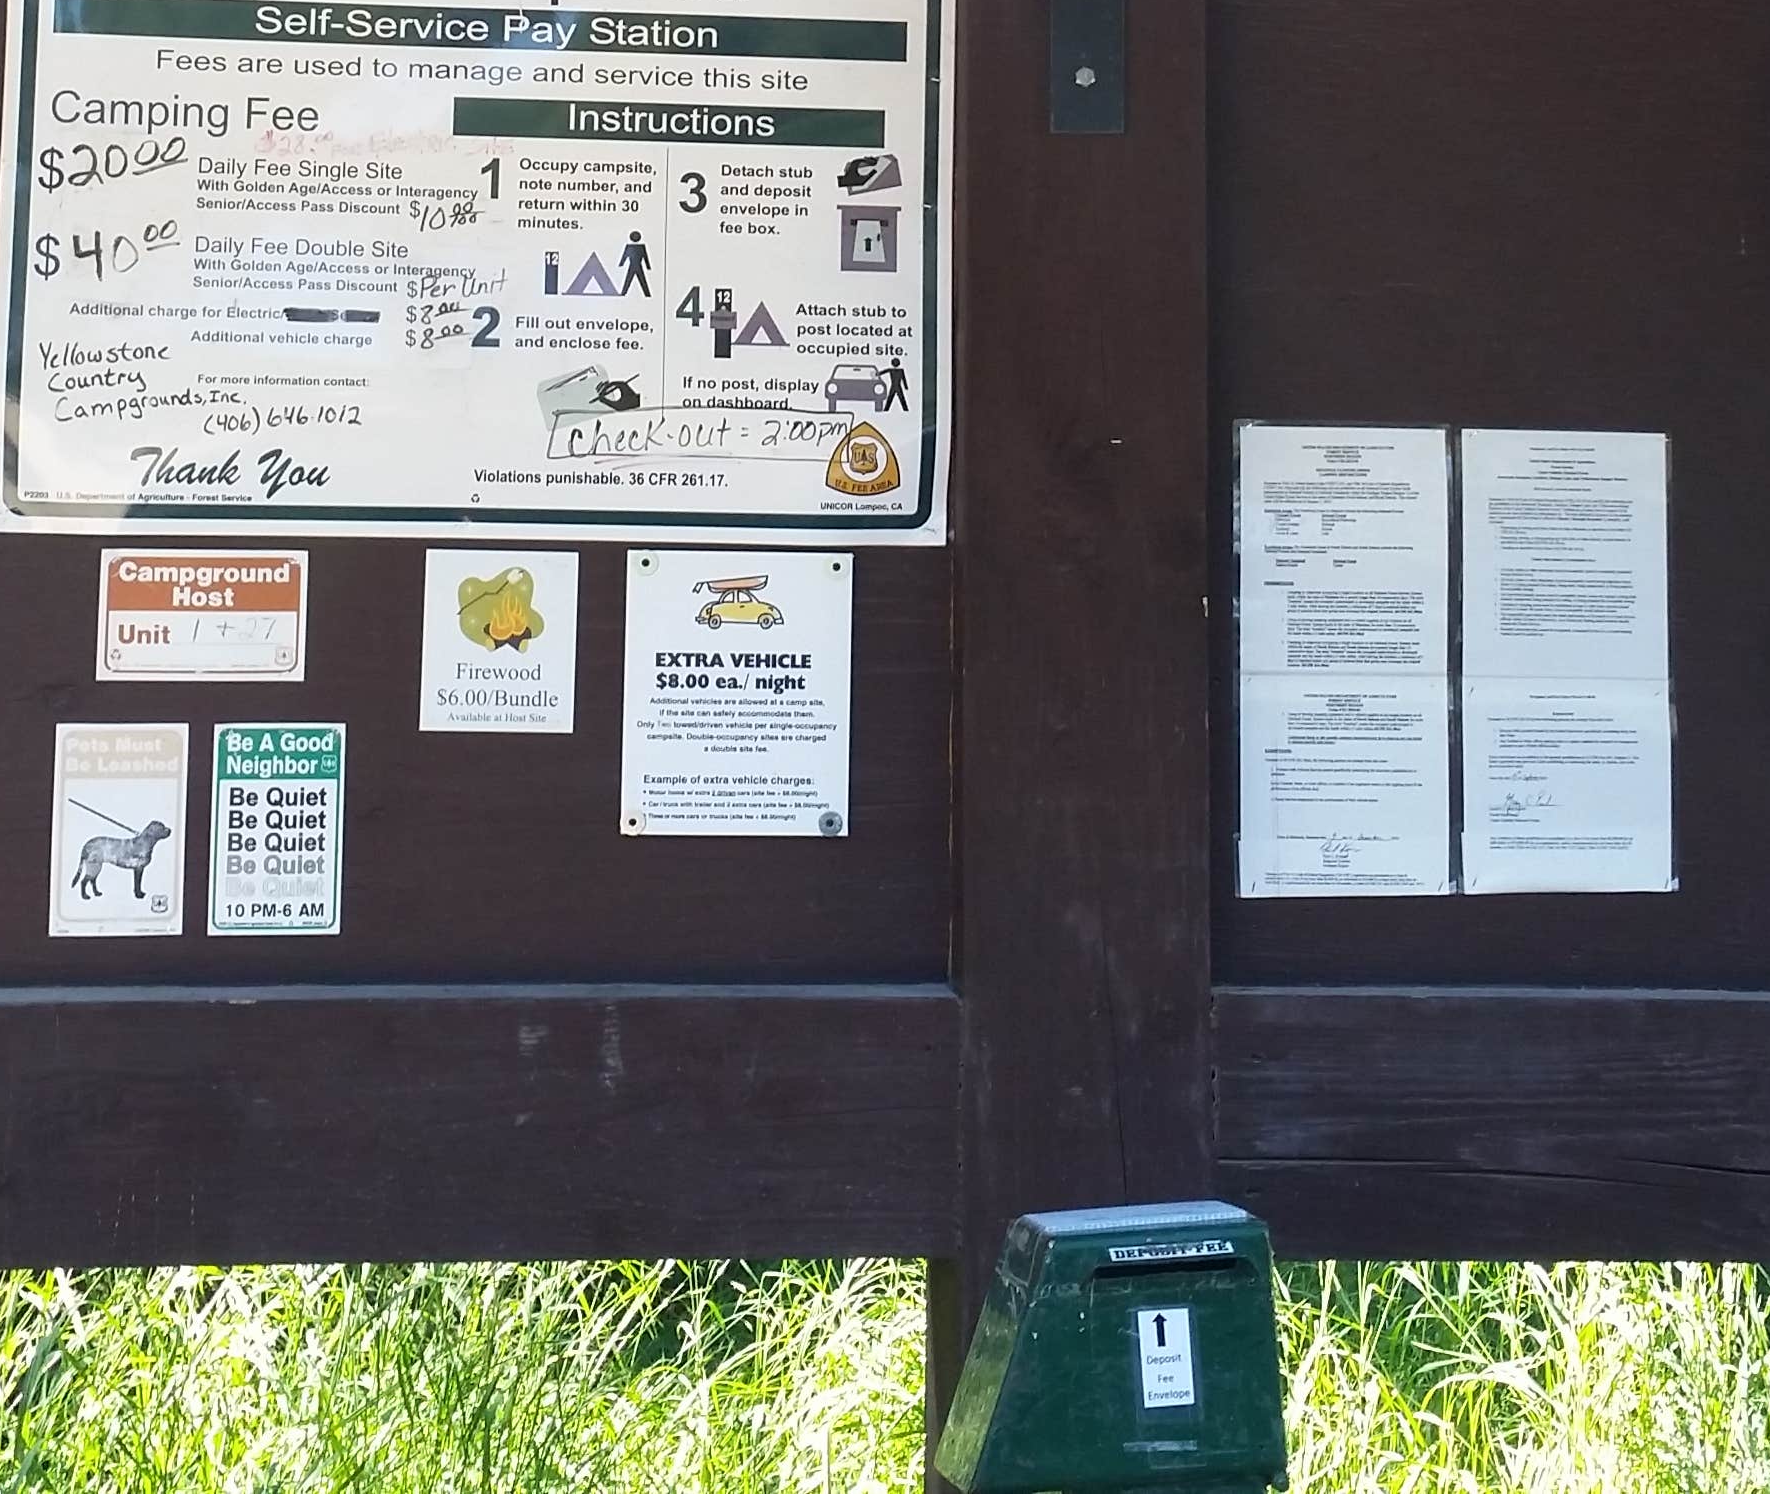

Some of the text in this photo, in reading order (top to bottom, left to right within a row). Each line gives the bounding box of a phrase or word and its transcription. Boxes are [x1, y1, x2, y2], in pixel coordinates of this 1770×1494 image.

[255, 7, 718, 50] Self-Service Pay Station
[156, 50, 808, 91] Fees are used to manage and service this site
[51, 90, 319, 137] Camping Fee
[569, 103, 775, 137] Instructions
[199, 157, 402, 182] Daily Fee Single Site
[519, 159, 657, 175] Occupy campsite,
[721, 165, 813, 178] Detach stub
[481, 158, 500, 199] 1
[519, 180, 652, 194] note number, and
[679, 172, 707, 213] 3
[721, 185, 811, 199] and deposit
[518, 199, 639, 211] return within 30
[720, 205, 808, 217] envelope in
[518, 218, 583, 229] minutes.
[720, 222, 780, 234] fee box.
[195, 236, 408, 258] Daily Fee Double Site
[40, 341, 173, 370] Yellowstone
[48, 370, 147, 393] Country
[131, 447, 331, 499] Thank You
[475, 469, 728, 489] Violations punishable. 36 CFR 261.17.
[119, 561, 290, 588] Campground
[172, 586, 234, 607] Host
[118, 625, 170, 644] Unit
[655, 652, 811, 668] EXTRA VEHICLE
[456, 663, 541, 681] Firewood
[656, 674, 709, 690] $8.00
[755, 675, 806, 694] night
[437, 688, 559, 707] $6.00/Bundle
[227, 733, 334, 752] Be A Good
[226, 755, 318, 778] Neighbor
[229, 787, 327, 808] Be Quiet
[229, 810, 326, 831] Be Quiet
[228, 833, 325, 854] Be Quiet
[226, 904, 324, 917] 10 PM-6 AM
[1146, 1354, 1181, 1366] Deposit
[1158, 1374, 1174, 1383] Fee
[1148, 1388, 1190, 1401] Envelope
